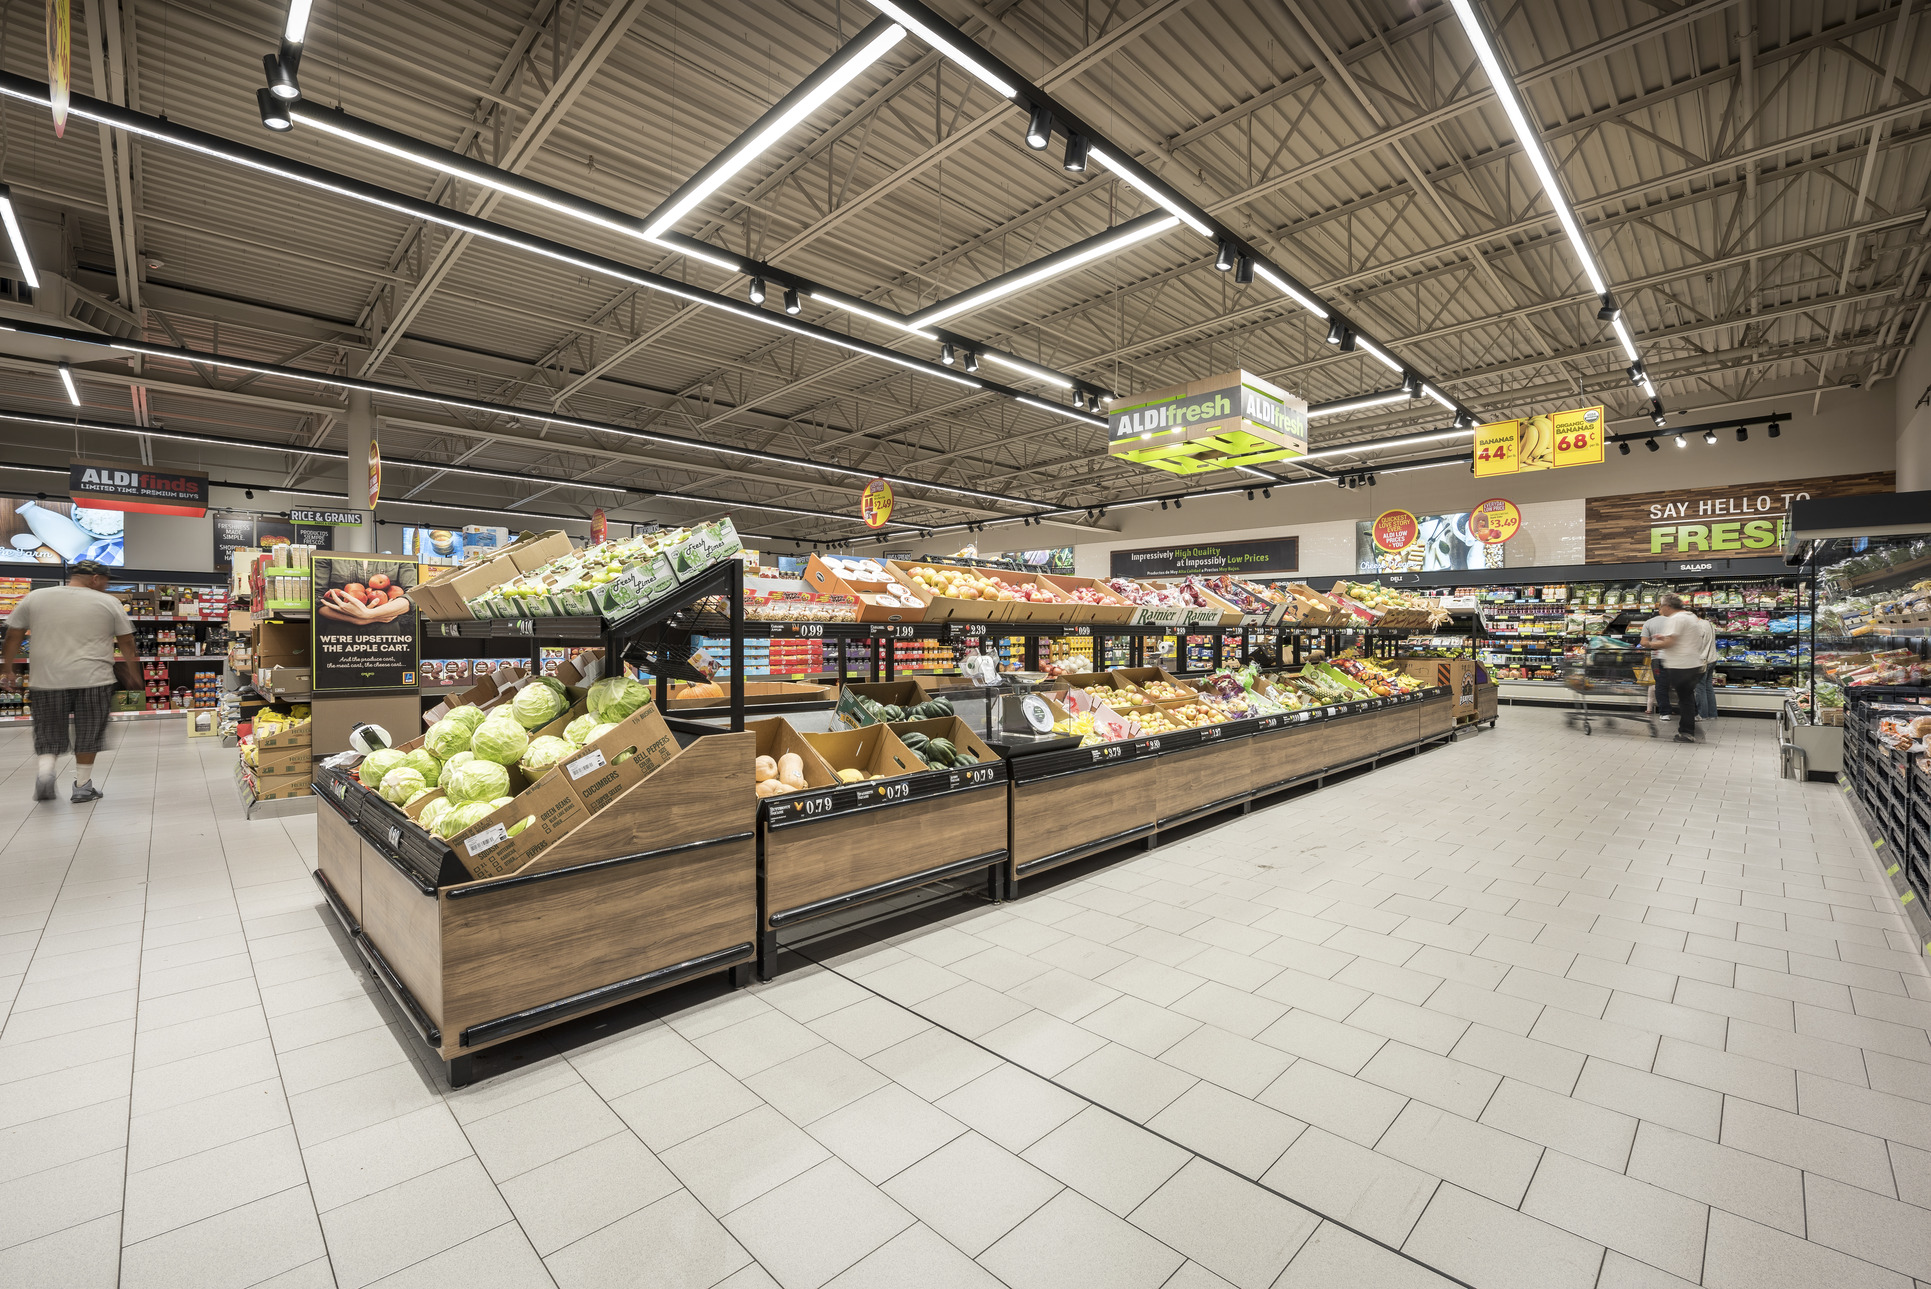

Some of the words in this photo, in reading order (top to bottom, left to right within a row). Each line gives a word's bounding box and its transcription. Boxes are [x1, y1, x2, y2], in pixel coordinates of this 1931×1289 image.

[1556, 424, 1594, 434] BANANAS
[1480, 436, 1514, 445] BANANAS
[81, 484, 115, 492] LIMITED
[141, 489, 177, 497] PREMIUM
[874, 499, 891, 510] $2.49
[1650, 502, 1689, 519] SAY
[1700, 496, 1771, 515] HELLO
[291, 511, 313, 521] RICE
[315, 512, 323, 521] &
[325, 513, 360, 524] GRAINS
[1381, 515, 1407, 523] QUICKEST
[1490, 518, 1517, 528] $3.49
[685, 538, 705, 556] Fresh
[1132, 551, 1173, 561] Impressively
[1175, 549, 1191, 559] High
[1193, 547, 1221, 557] Quality
[1186, 556, 1226, 567] Impossibly
[1228, 555, 1243, 564] Low
[1245, 553, 1269, 563] Prices
[613, 572, 636, 592] Fresh
[1137, 609, 1177, 624] Rainier
[1183, 611, 1218, 625] Rainier
[801, 625, 823, 636] 0.99
[895, 626, 914, 637] 1.99
[971, 625, 986, 635] 2.39
[320, 635, 352, 643] WE'RE
[356, 635, 412, 643] UPSETTING
[639, 707, 654, 719] BUSHEL
[633, 752, 648, 764] BELL
[646, 735, 669, 755] PEPPERS
[639, 758, 651, 768] COLOR
[974, 769, 993, 782] 0.79
[582, 771, 619, 798] CUCUMBERS
[887, 783, 909, 799] 0.79
[596, 793, 609, 804] SUPER
[608, 784, 622, 796] SELECT
[540, 807, 556, 821] GREEN
[555, 796, 571, 810] BEANS
[564, 803, 575, 812] BEANS
[806, 797, 832, 814] 0.79
[552, 819, 563, 828] OTHER
[478, 844, 499, 860] SQUASH
[496, 841, 515, 856] BUTTERNUT
[500, 848, 516, 861] KABOCHA
[525, 840, 547, 858] PEPPERS
[504, 857, 516, 866] OTHER
